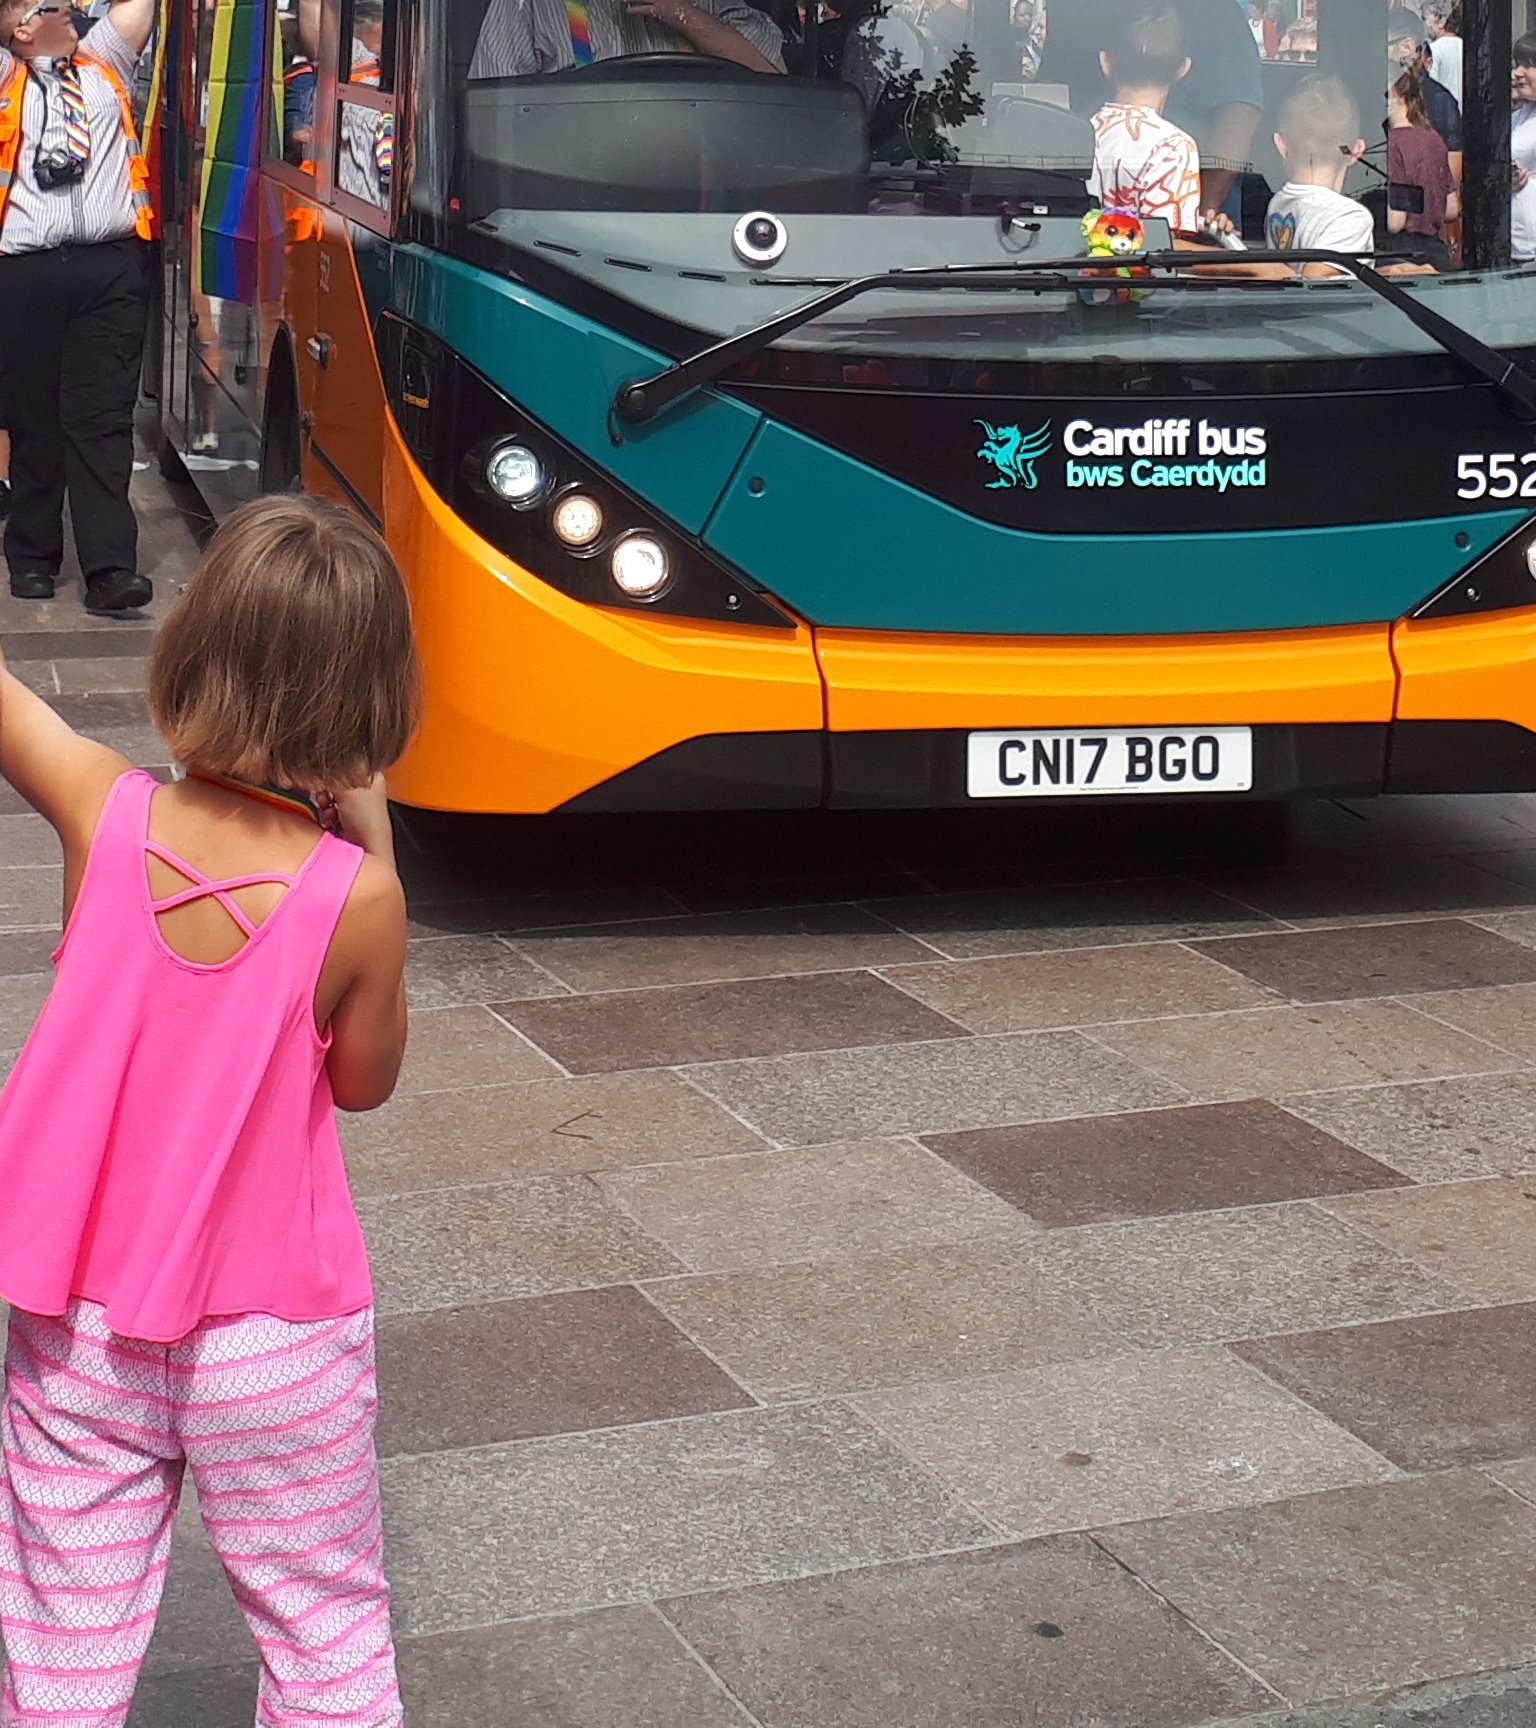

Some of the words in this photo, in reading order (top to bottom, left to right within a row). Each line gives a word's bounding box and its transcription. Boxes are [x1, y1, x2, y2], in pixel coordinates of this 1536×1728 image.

[1063, 419, 1191, 457] Cardiff
[1198, 419, 1267, 456] bus
[1066, 458, 1125, 487] bws
[1130, 458, 1267, 493] Caerdydd
[998, 737, 1108, 787] CN17
[1124, 735, 1220, 783] BGO
